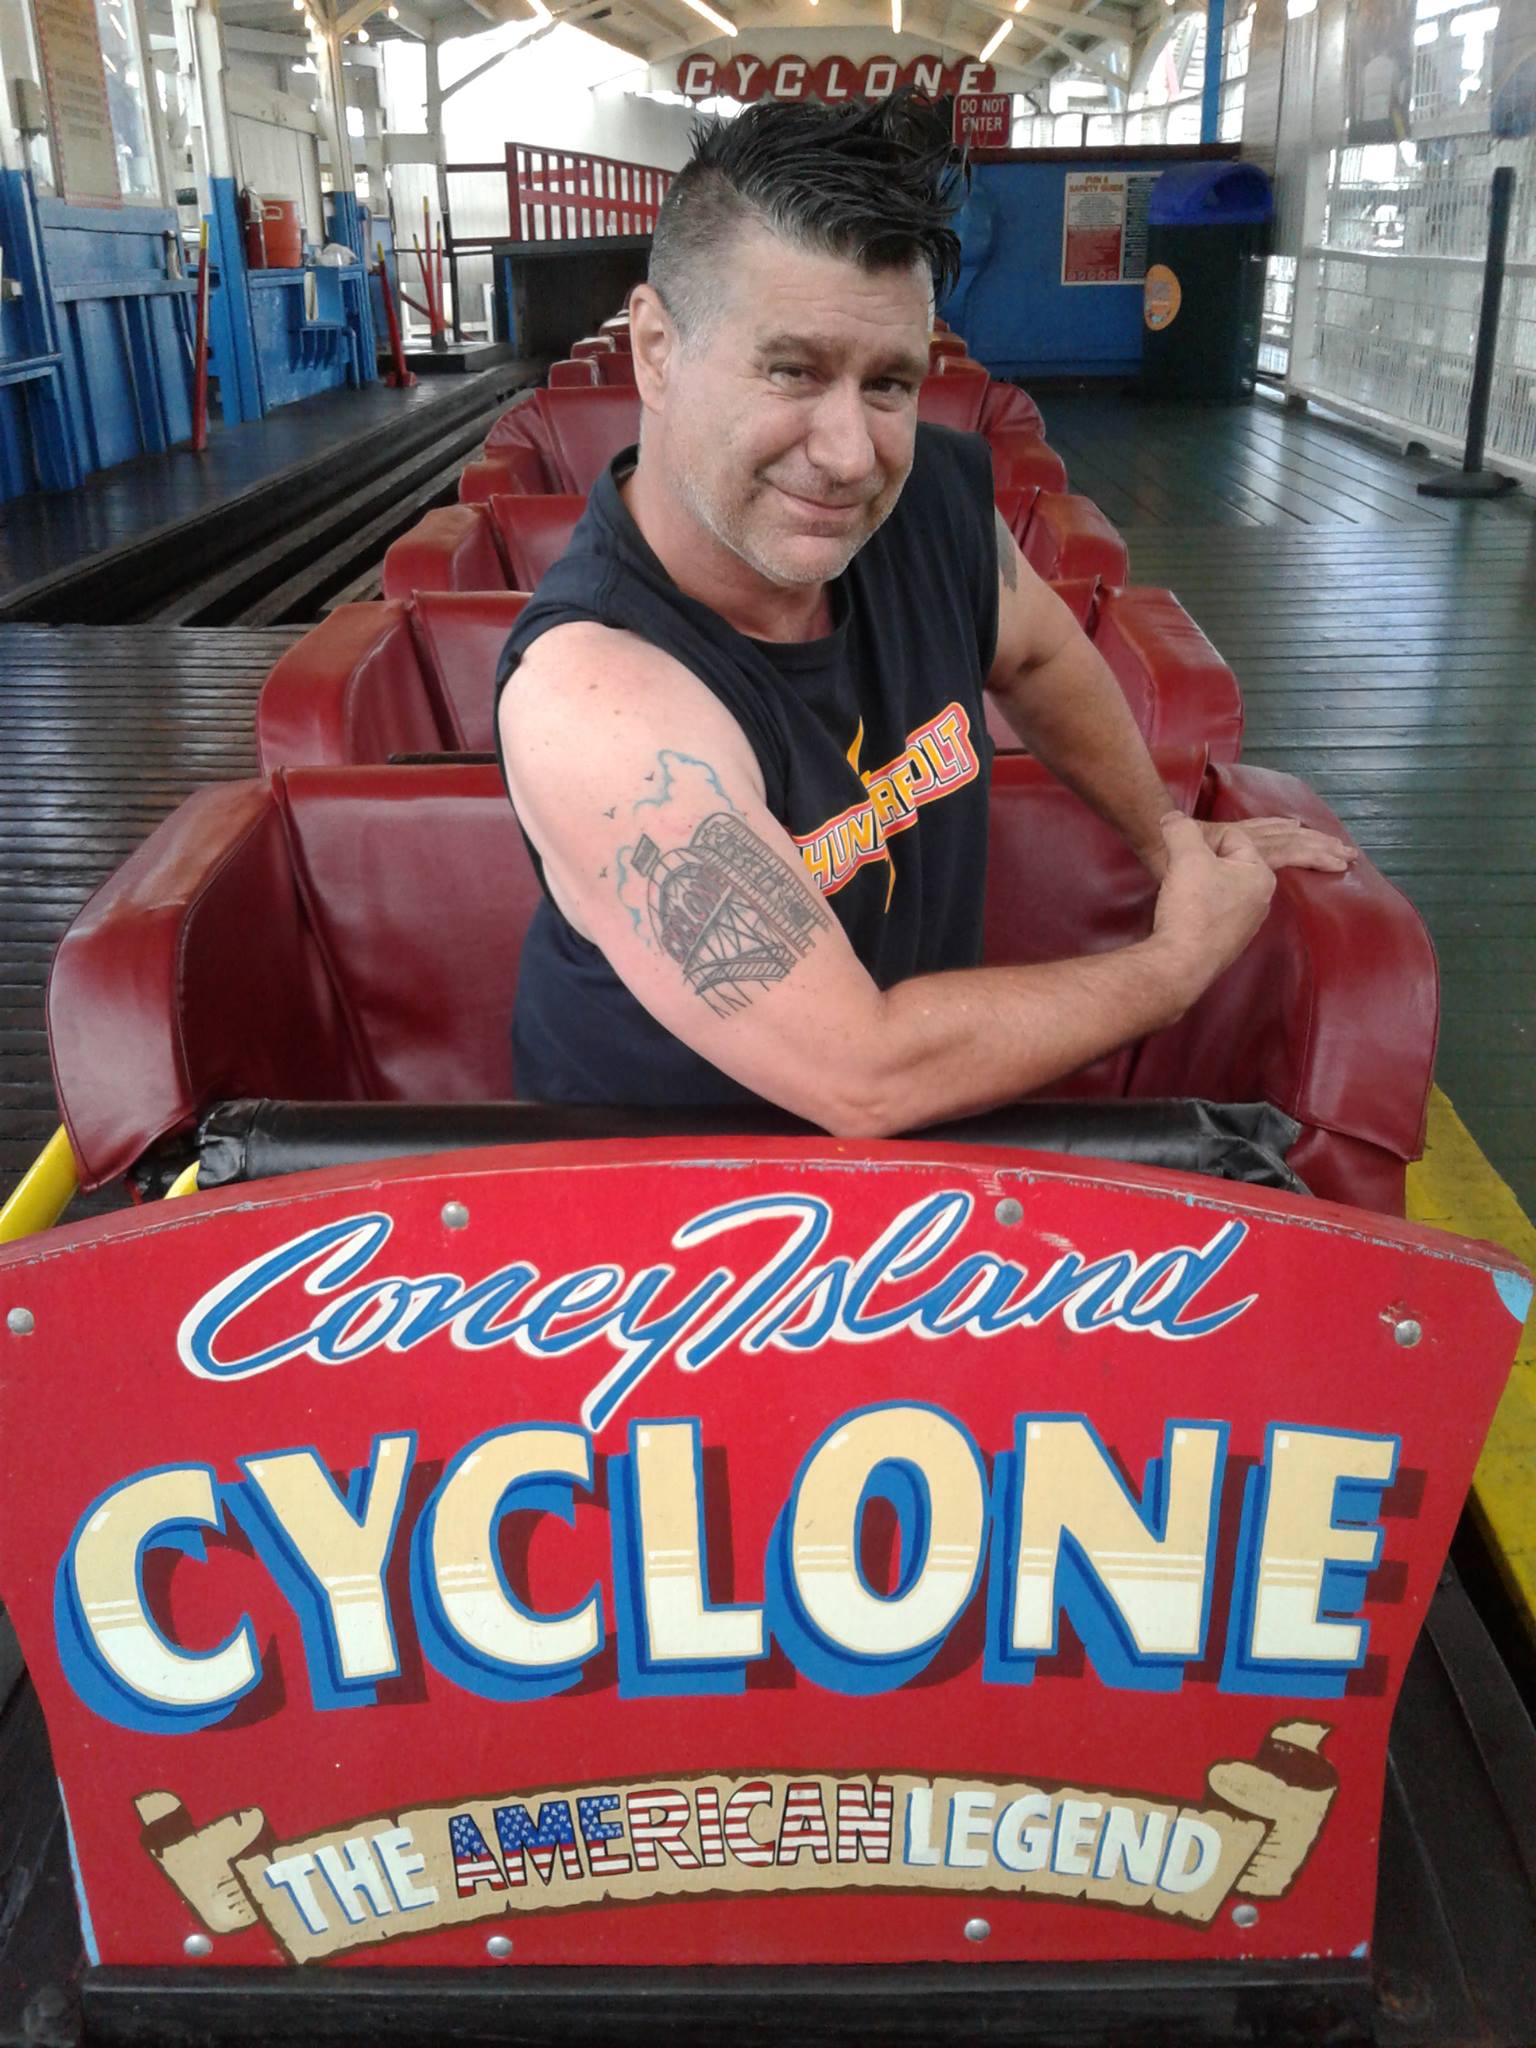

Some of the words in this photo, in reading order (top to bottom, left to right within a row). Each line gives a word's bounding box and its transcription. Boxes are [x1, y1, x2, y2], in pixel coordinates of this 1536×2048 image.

[684, 61, 987, 96] CYCLONE
[960, 99, 977, 113] DO
[982, 98, 1006, 113] NOT
[962, 116, 1002, 132] ENTER
[177, 1212, 735, 1433] Coney
[671, 1190, 1260, 1373] Island
[58, 1400, 1400, 1728] CYCLONE
[265, 1827, 439, 1935] THE
[448, 1782, 893, 1898] AMERICAN
[903, 1786, 1223, 1893] LEGEND
